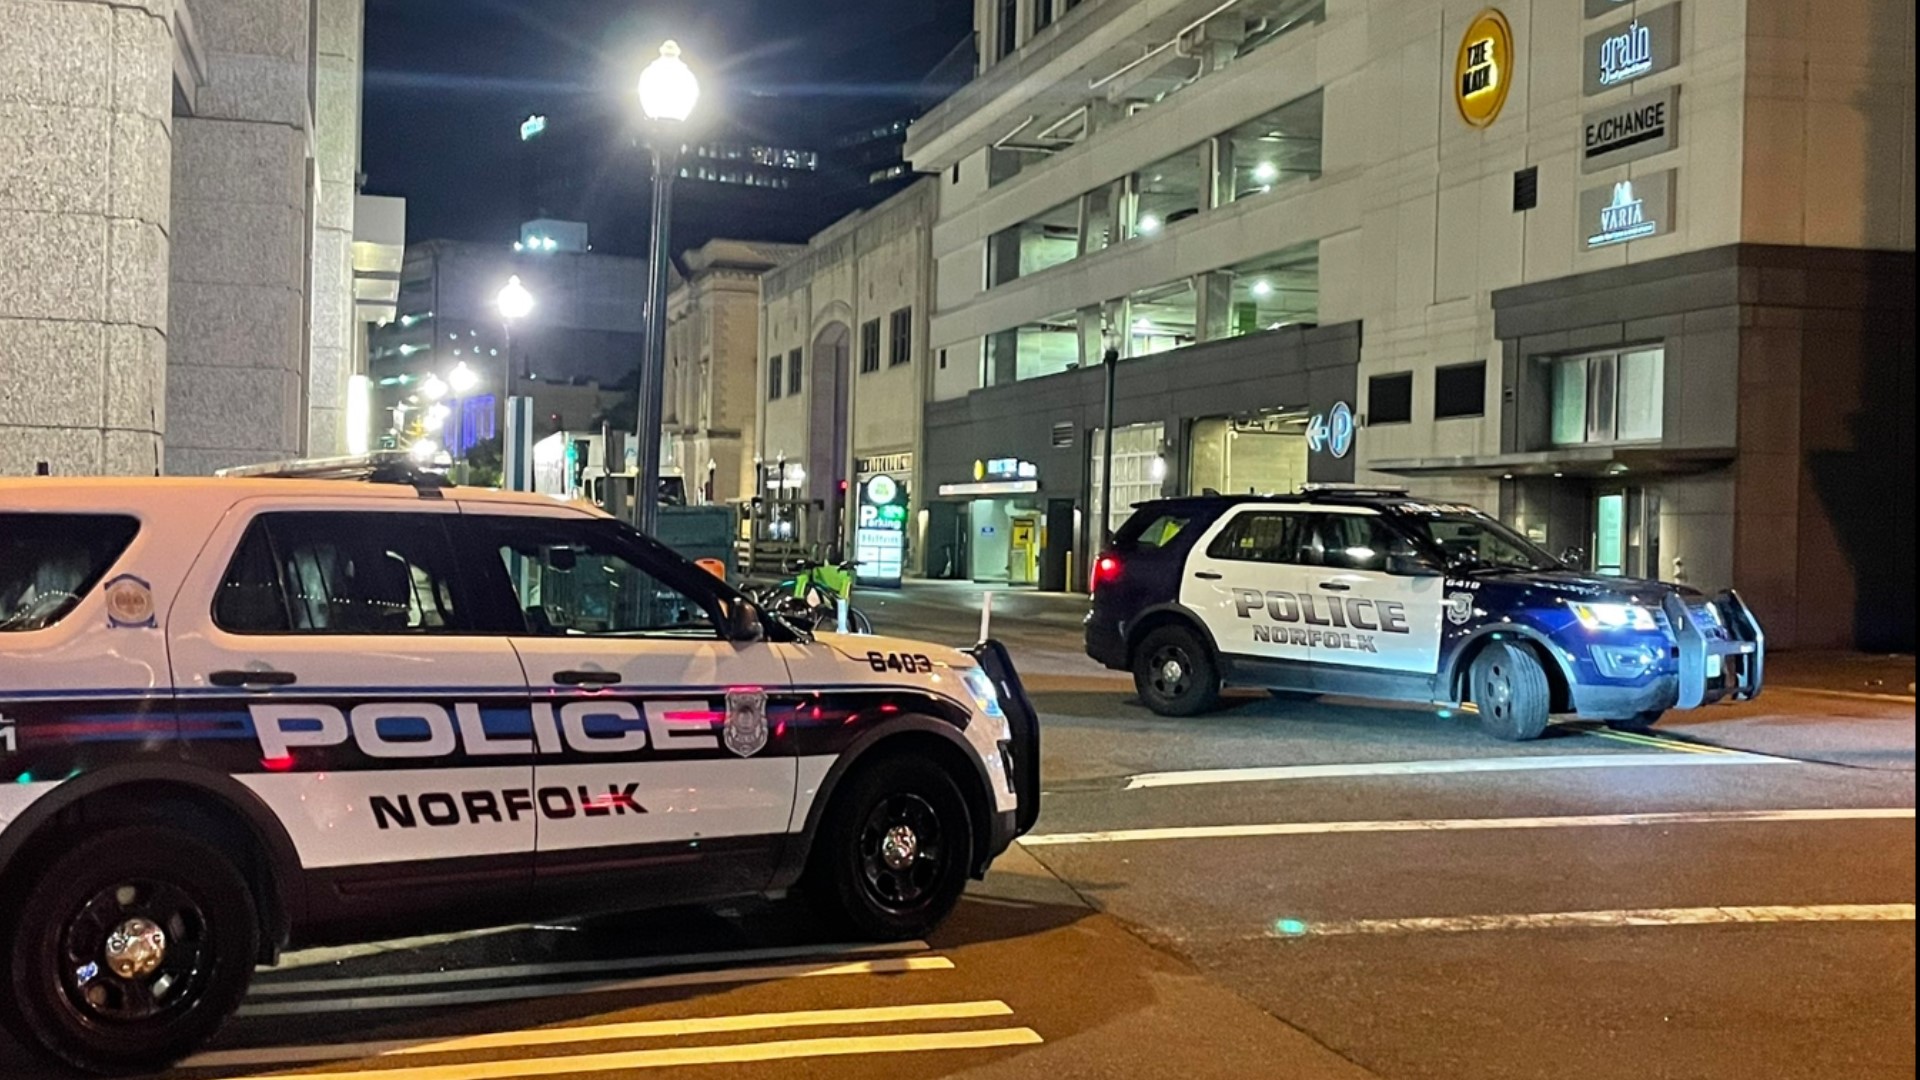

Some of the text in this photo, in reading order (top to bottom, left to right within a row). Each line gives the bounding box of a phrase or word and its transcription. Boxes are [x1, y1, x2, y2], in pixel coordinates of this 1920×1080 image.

[1467, 39, 1489, 68] THE
[1600, 19, 1650, 85] grain
[1585, 102, 1665, 146] EXCHANGE
[1601, 205, 1643, 232] VARIA
[1232, 587, 1410, 635] POLICE
[1253, 624, 1377, 653] NORFOLK
[866, 651, 932, 673] 6403
[248, 702, 721, 761] POLICE
[369, 783, 648, 829] NORFOLK
